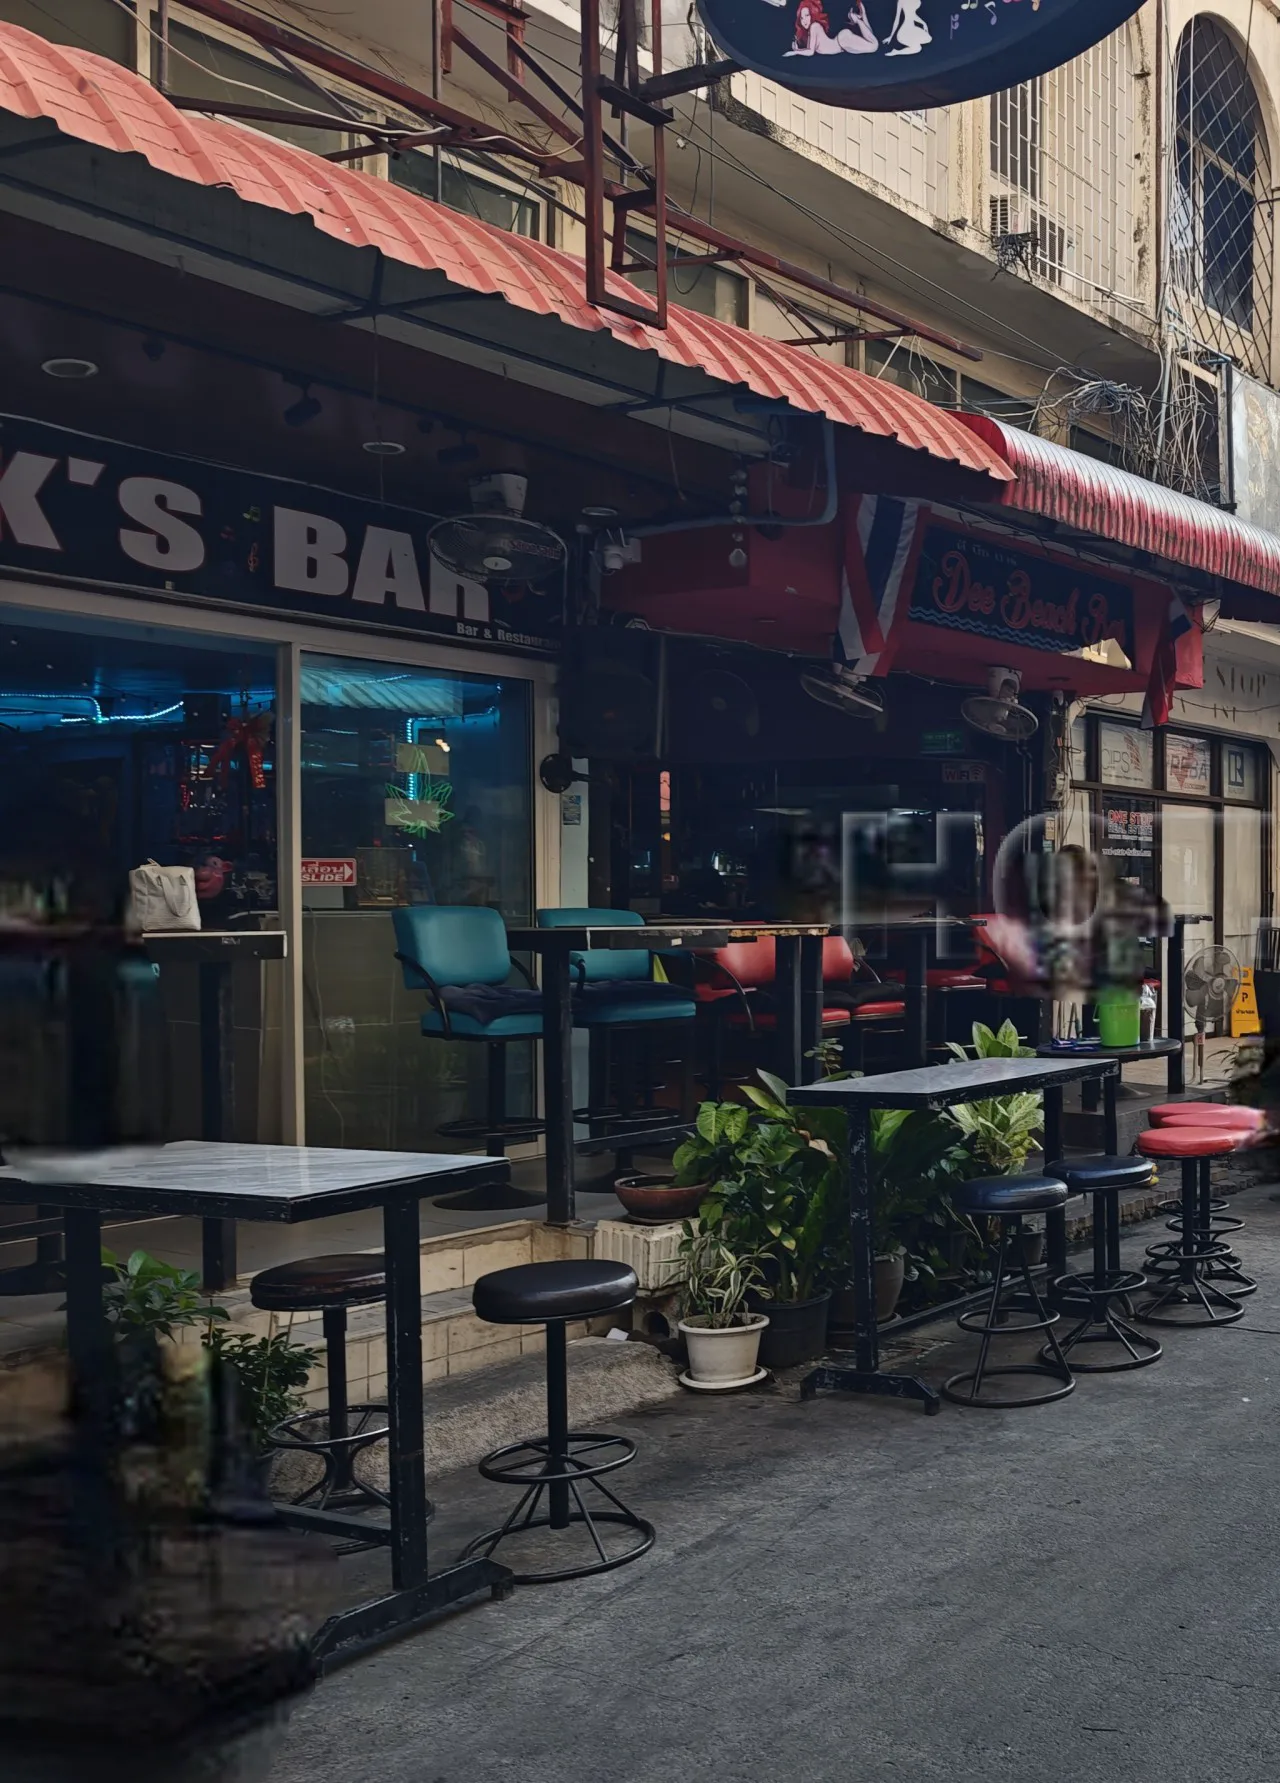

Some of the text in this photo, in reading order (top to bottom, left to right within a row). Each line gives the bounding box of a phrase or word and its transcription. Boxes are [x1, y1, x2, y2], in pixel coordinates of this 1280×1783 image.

[932, 551, 996, 614] Dee
[456, 622, 479, 637] Bar
[483, 626, 493, 640] &
[1107, 809, 1153, 827] ONE STOP
[302, 873, 345, 882] SLIDE
